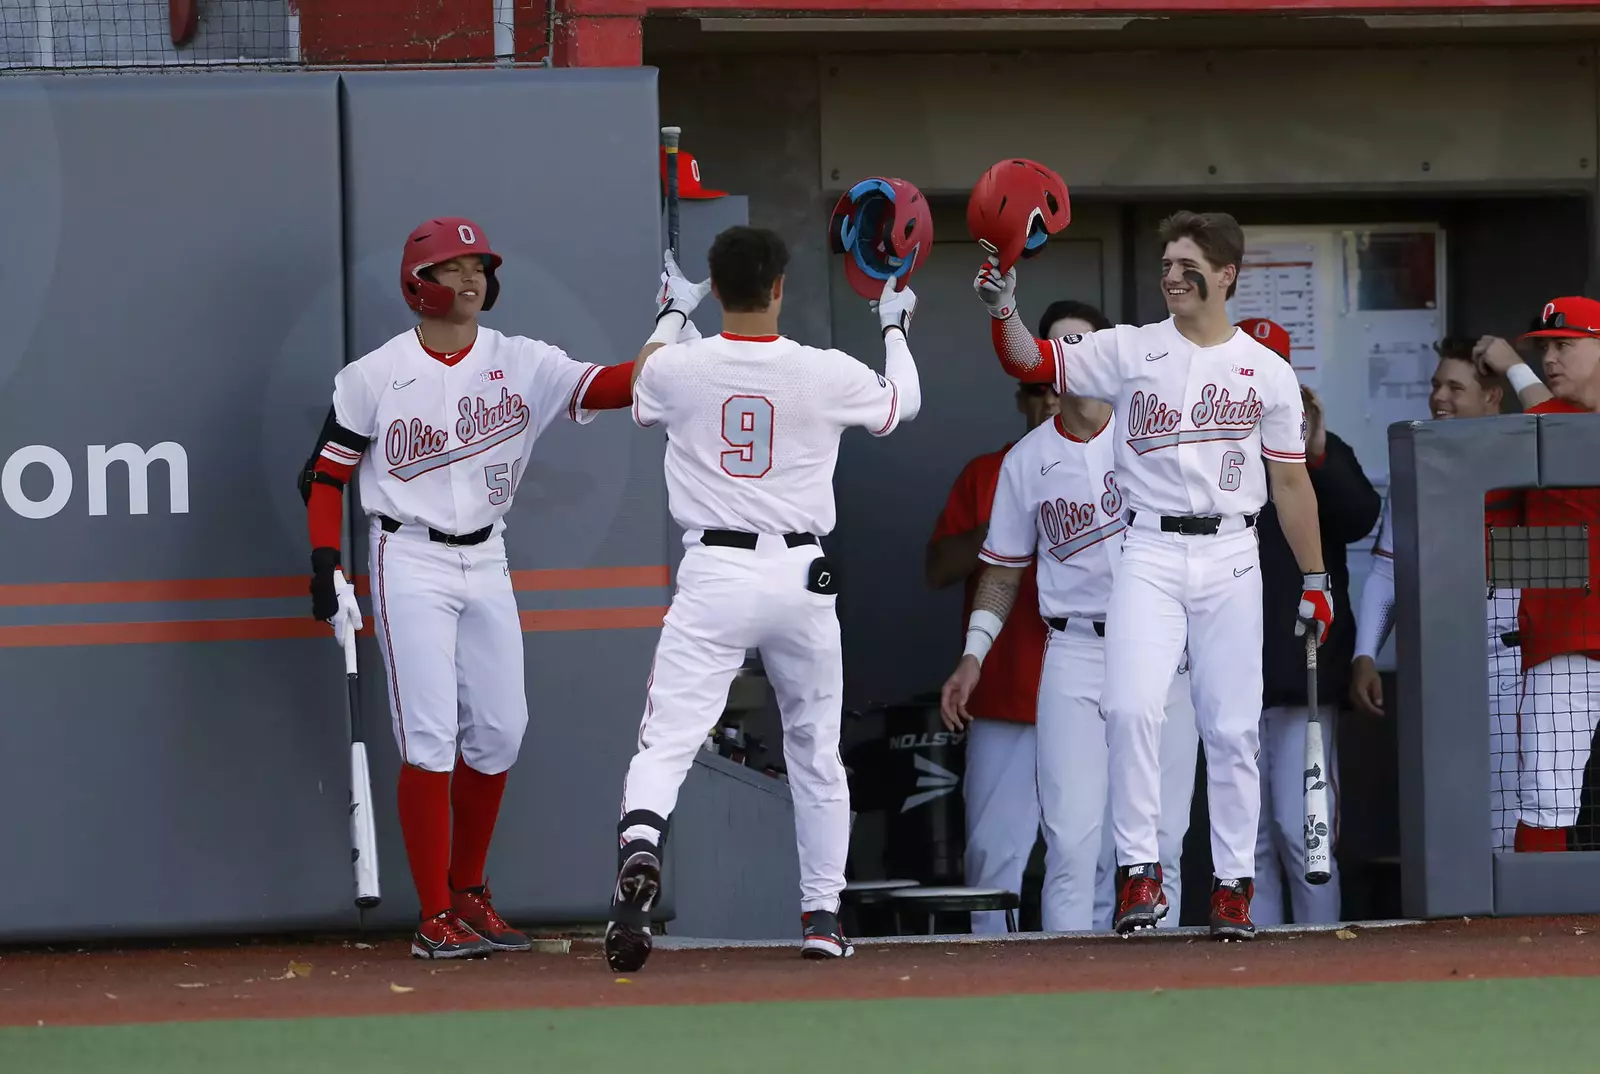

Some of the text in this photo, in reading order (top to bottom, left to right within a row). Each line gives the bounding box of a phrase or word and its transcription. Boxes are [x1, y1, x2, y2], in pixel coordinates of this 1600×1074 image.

[457, 224, 476, 245] O
[1254, 321, 1271, 339] O
[385, 387, 524, 466] Ohio State
[1128, 383, 1264, 437] Ohio State
[720, 394, 775, 478] 9
[1, 441, 189, 519] om
[1218, 450, 1246, 492] 6
[1041, 498, 1096, 545] Ohio
[889, 731, 964, 750] ASTON
[1128, 865, 1145, 877] NIKE
